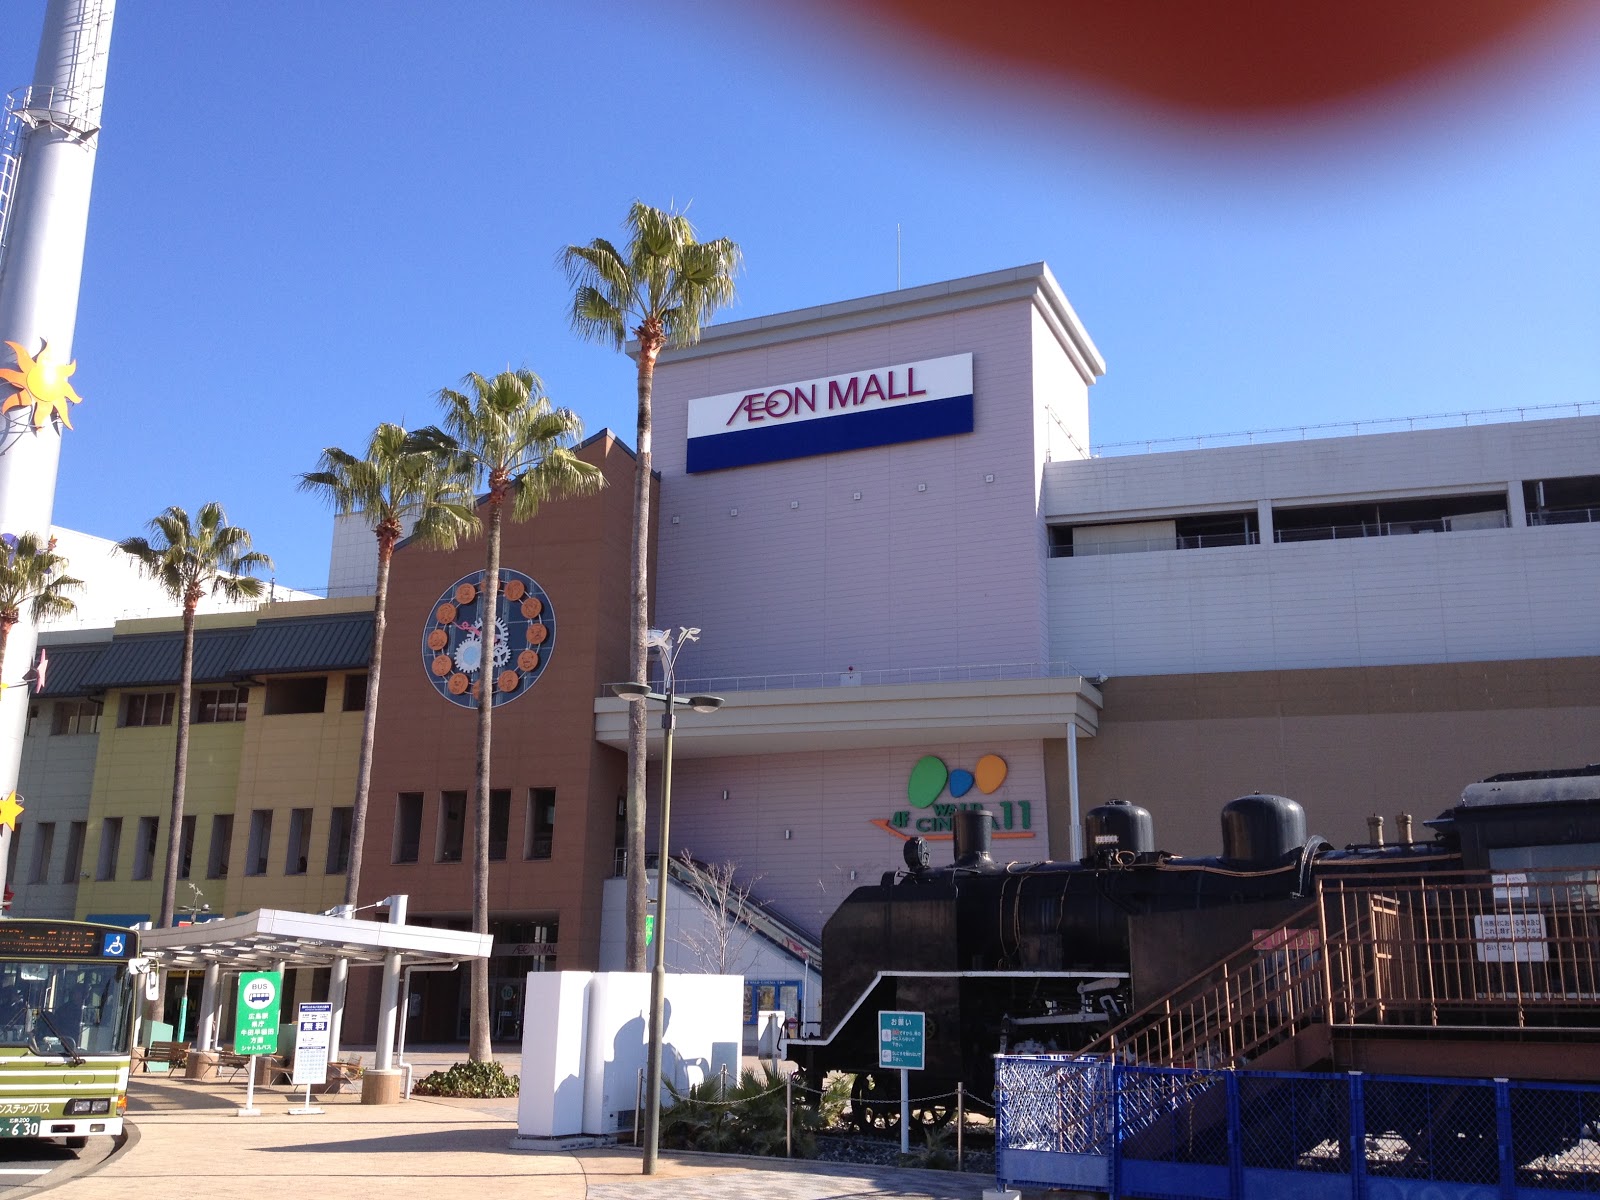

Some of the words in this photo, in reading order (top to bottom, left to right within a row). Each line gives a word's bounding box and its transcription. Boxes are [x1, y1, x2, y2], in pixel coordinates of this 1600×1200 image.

[828, 367, 927, 410] MALL
[892, 811, 911, 828] 4F
[1000, 800, 1032, 830] 11
